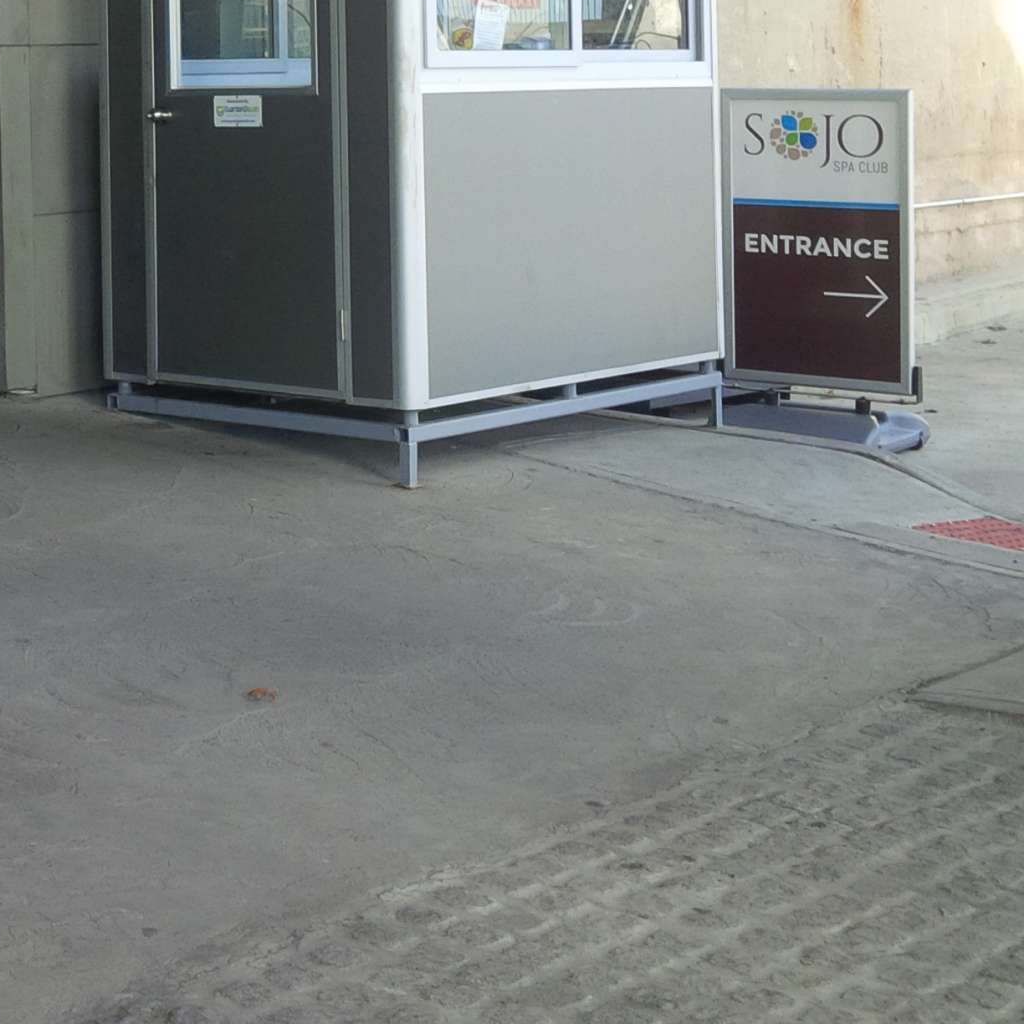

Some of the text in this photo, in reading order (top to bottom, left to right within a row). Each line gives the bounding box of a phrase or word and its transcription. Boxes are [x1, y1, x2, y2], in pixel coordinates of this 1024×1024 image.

[833, 161, 889, 174] SPA CLUB
[744, 232, 890, 260] ENTRANCE
